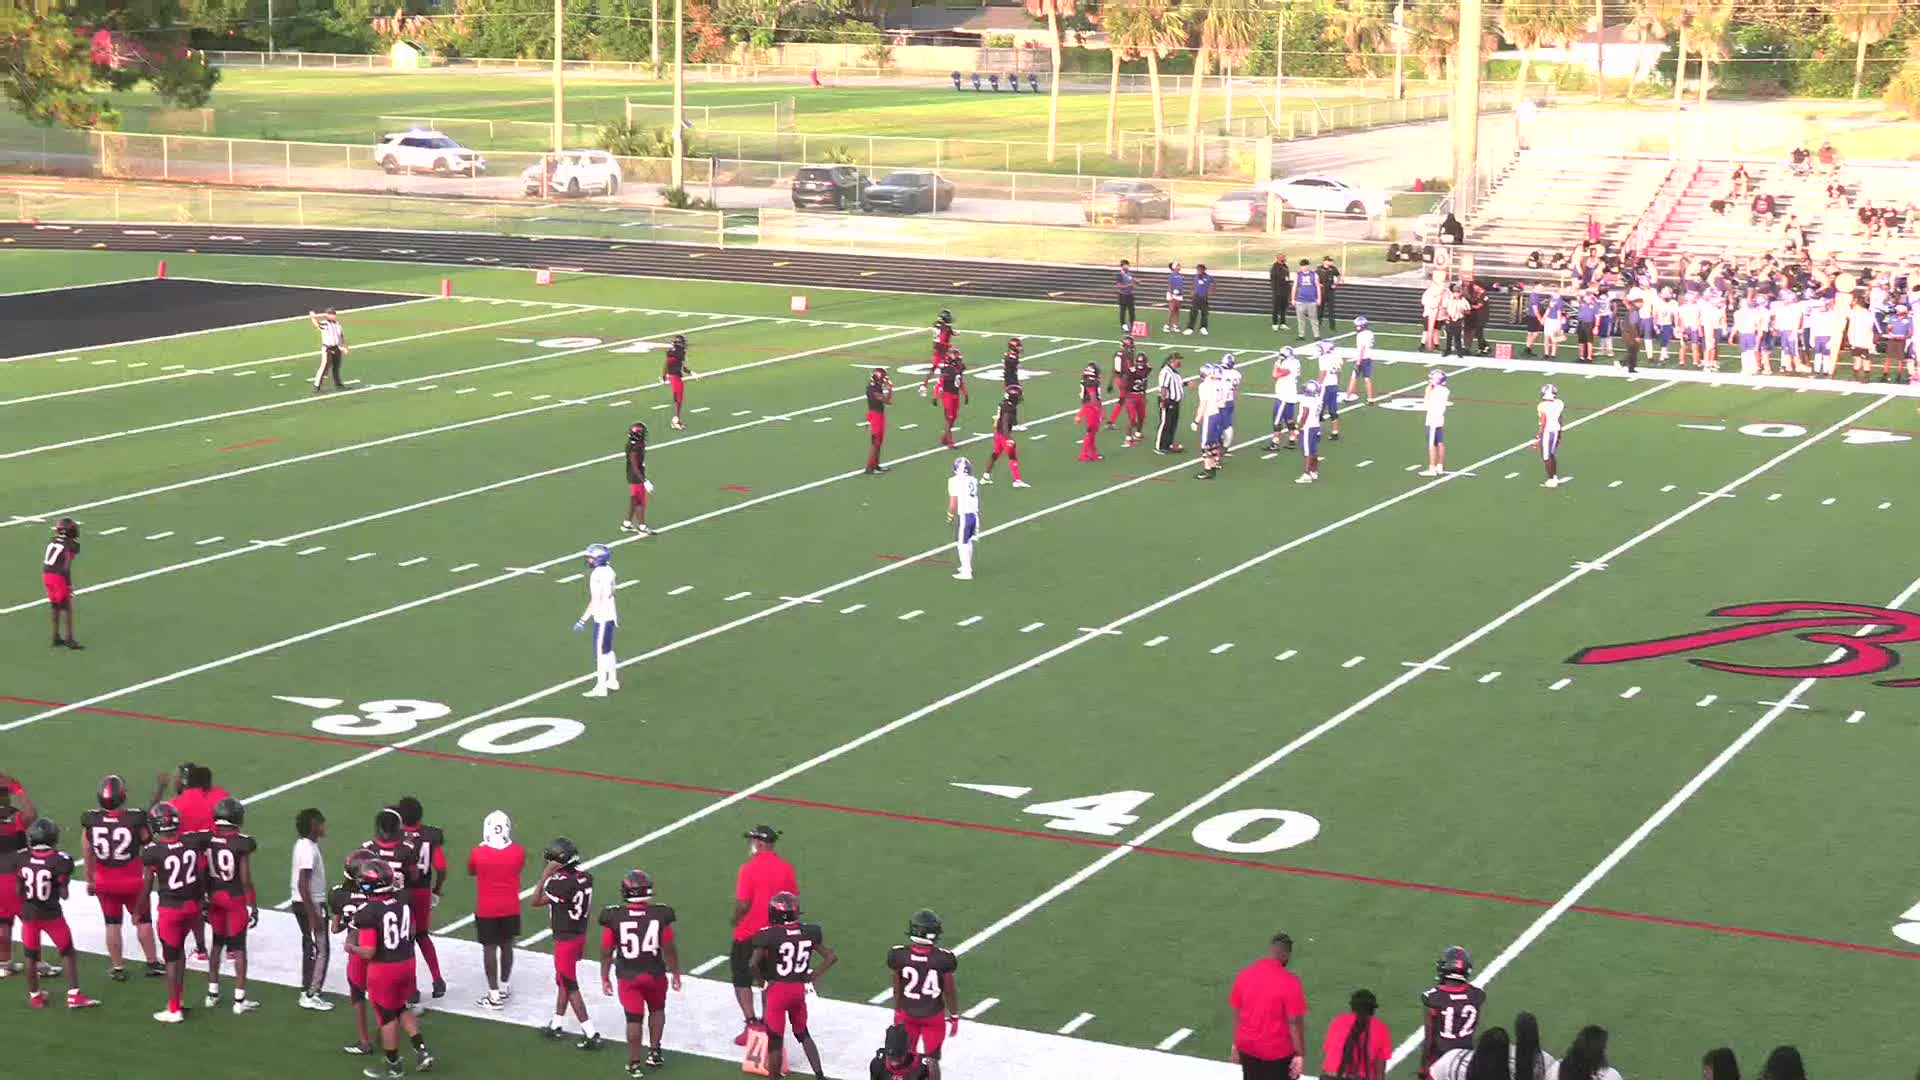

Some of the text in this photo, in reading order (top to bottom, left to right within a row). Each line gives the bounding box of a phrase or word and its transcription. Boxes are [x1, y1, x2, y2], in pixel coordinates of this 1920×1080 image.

[92, 826, 133, 860] 52
[164, 850, 197, 890] 22
[205, 848, 235, 882] 19
[21, 867, 52, 902] 36
[568, 887, 593, 921] 37
[383, 903, 411, 950] 64
[619, 919, 660, 960] 54
[777, 940, 812, 977] 35
[902, 967, 942, 1000] 24
[1439, 1004, 1478, 1039] 12
